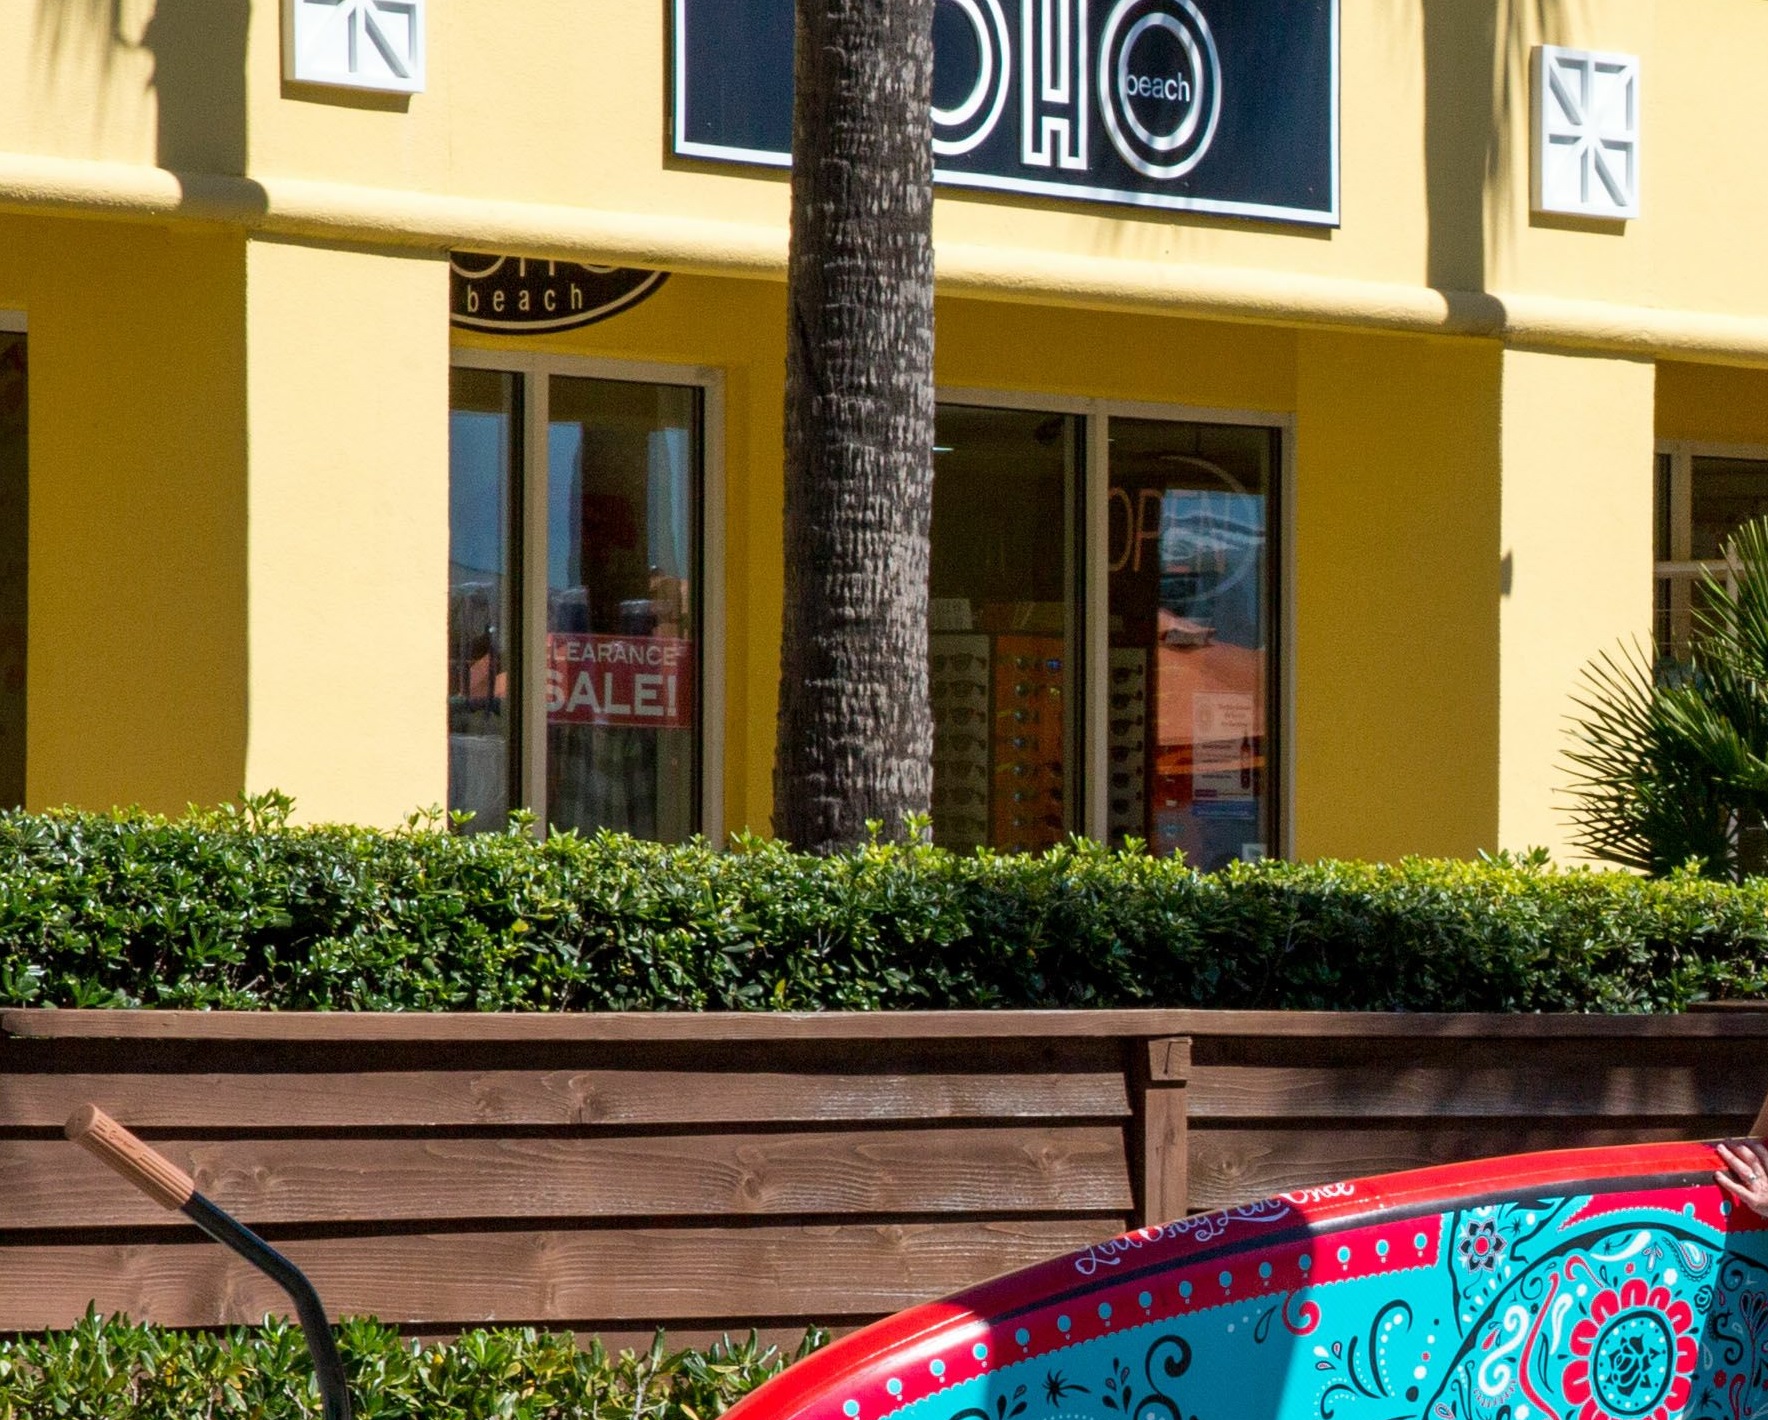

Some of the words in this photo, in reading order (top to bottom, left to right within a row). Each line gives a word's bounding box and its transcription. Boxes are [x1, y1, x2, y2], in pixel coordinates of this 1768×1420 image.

[467, 283, 583, 313] beach
[547, 638, 677, 667] LEARANCE
[546, 668, 677, 717] SALE!
